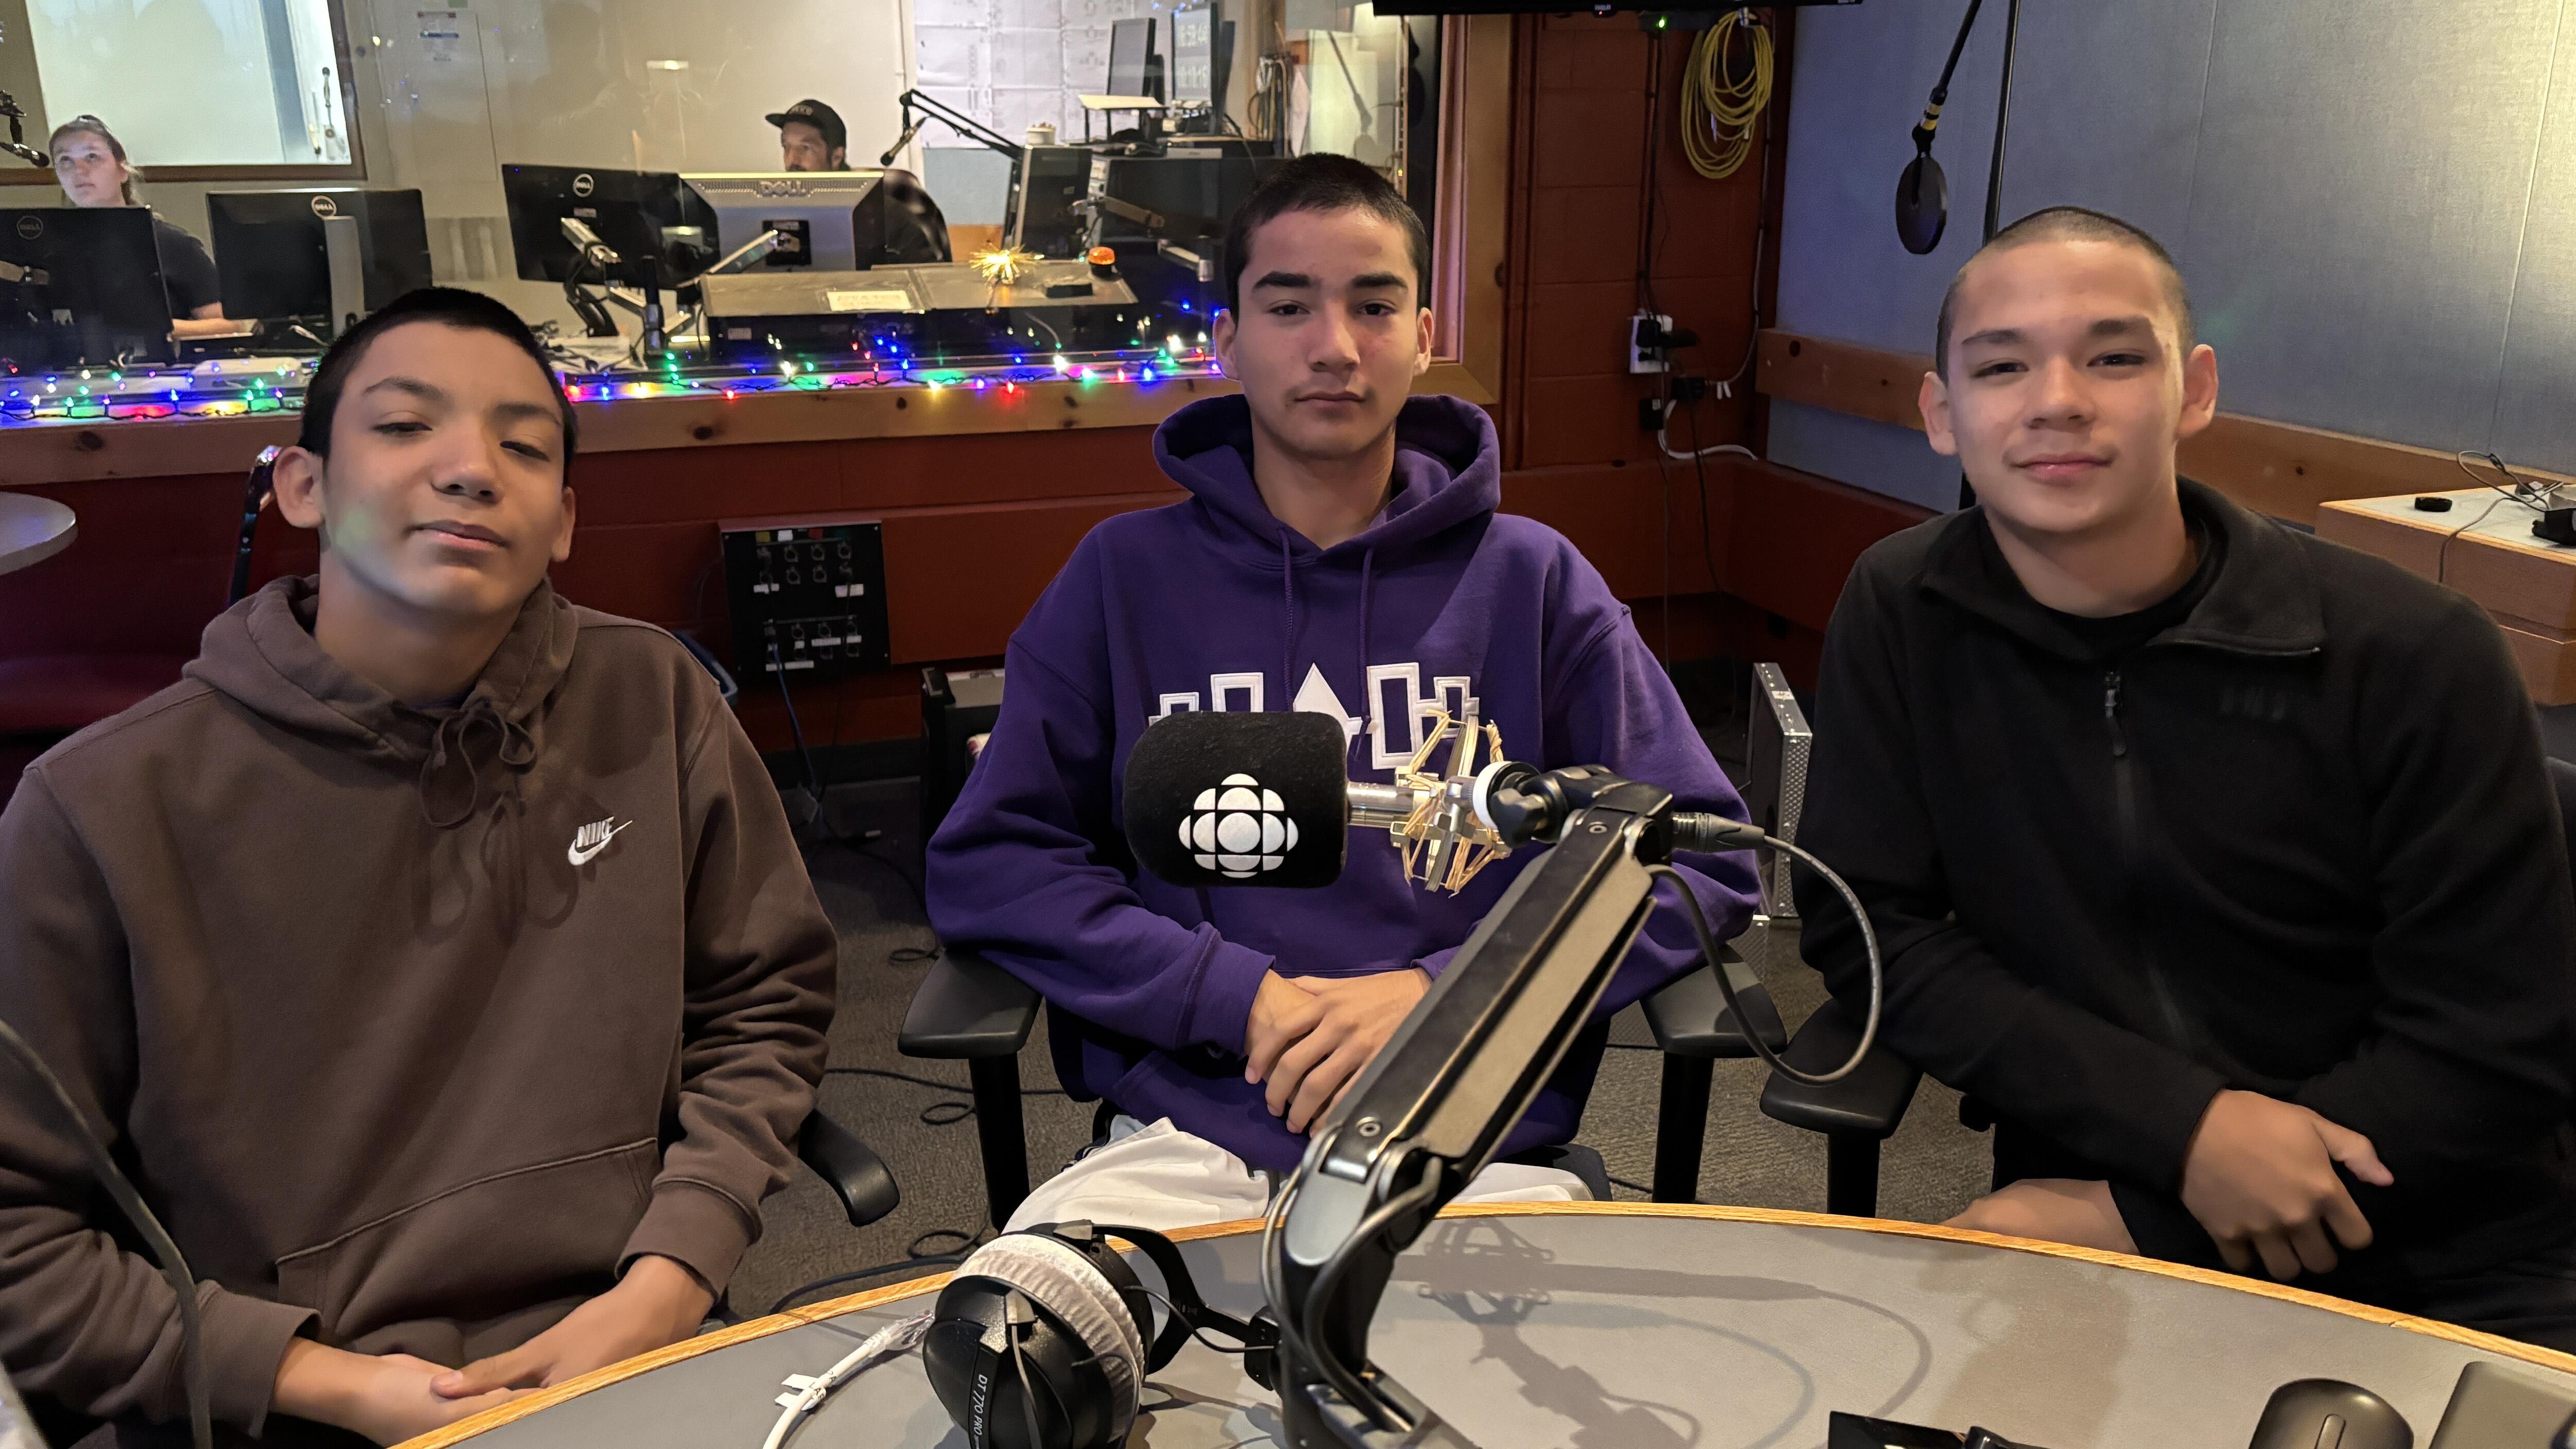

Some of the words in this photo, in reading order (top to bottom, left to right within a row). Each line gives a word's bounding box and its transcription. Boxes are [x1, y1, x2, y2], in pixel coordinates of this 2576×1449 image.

[577, 816, 614, 848] NIKE
[977, 1374, 988, 1392] DT
[973, 1390, 985, 1413] 770
[974, 1415, 982, 1436] PRO
